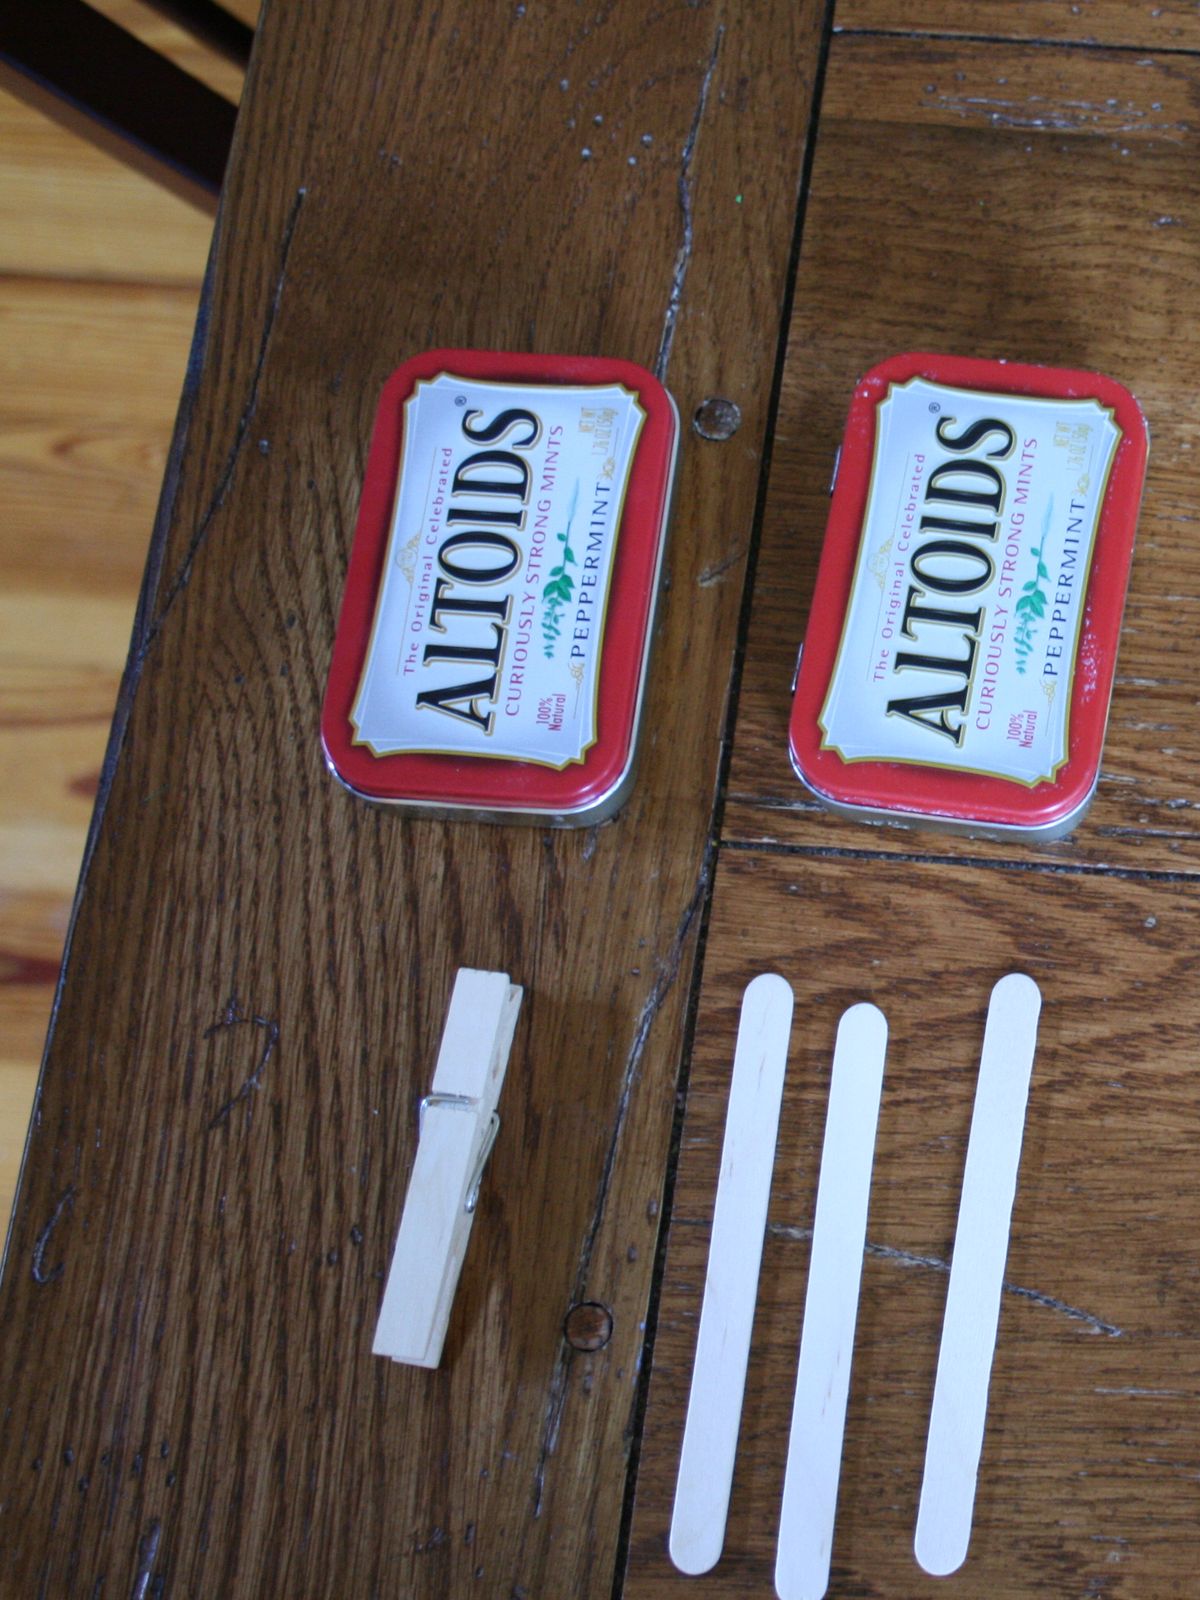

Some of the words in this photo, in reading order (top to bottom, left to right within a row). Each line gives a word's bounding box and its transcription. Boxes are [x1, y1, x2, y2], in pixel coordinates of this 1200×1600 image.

[426, 447, 452, 544] Celebrated
[897, 453, 925, 552] Celebrated
[410, 555, 434, 632] Original
[416, 408, 540, 732] ALTOIDS
[505, 592, 537, 716] CURIOUSLY
[525, 500, 551, 584] STRONG
[541, 426, 563, 491] MINTS
[570, 482, 610, 658] PEPPERMINT
[880, 561, 904, 639] Original
[886, 416, 1013, 744] ALTOIDS
[976, 606, 1008, 730] CURIOUSLY
[999, 513, 1025, 597] STRONG
[1014, 438, 1037, 504] MINTS
[1044, 499, 1085, 676] PEPPERMINT
[403, 643, 420, 675] The
[873, 649, 889, 682] The
[537, 698, 553, 725] 100%
[550, 694, 567, 731] Natural
[1007, 713, 1023, 740] 100%
[1020, 710, 1037, 748] Natural
